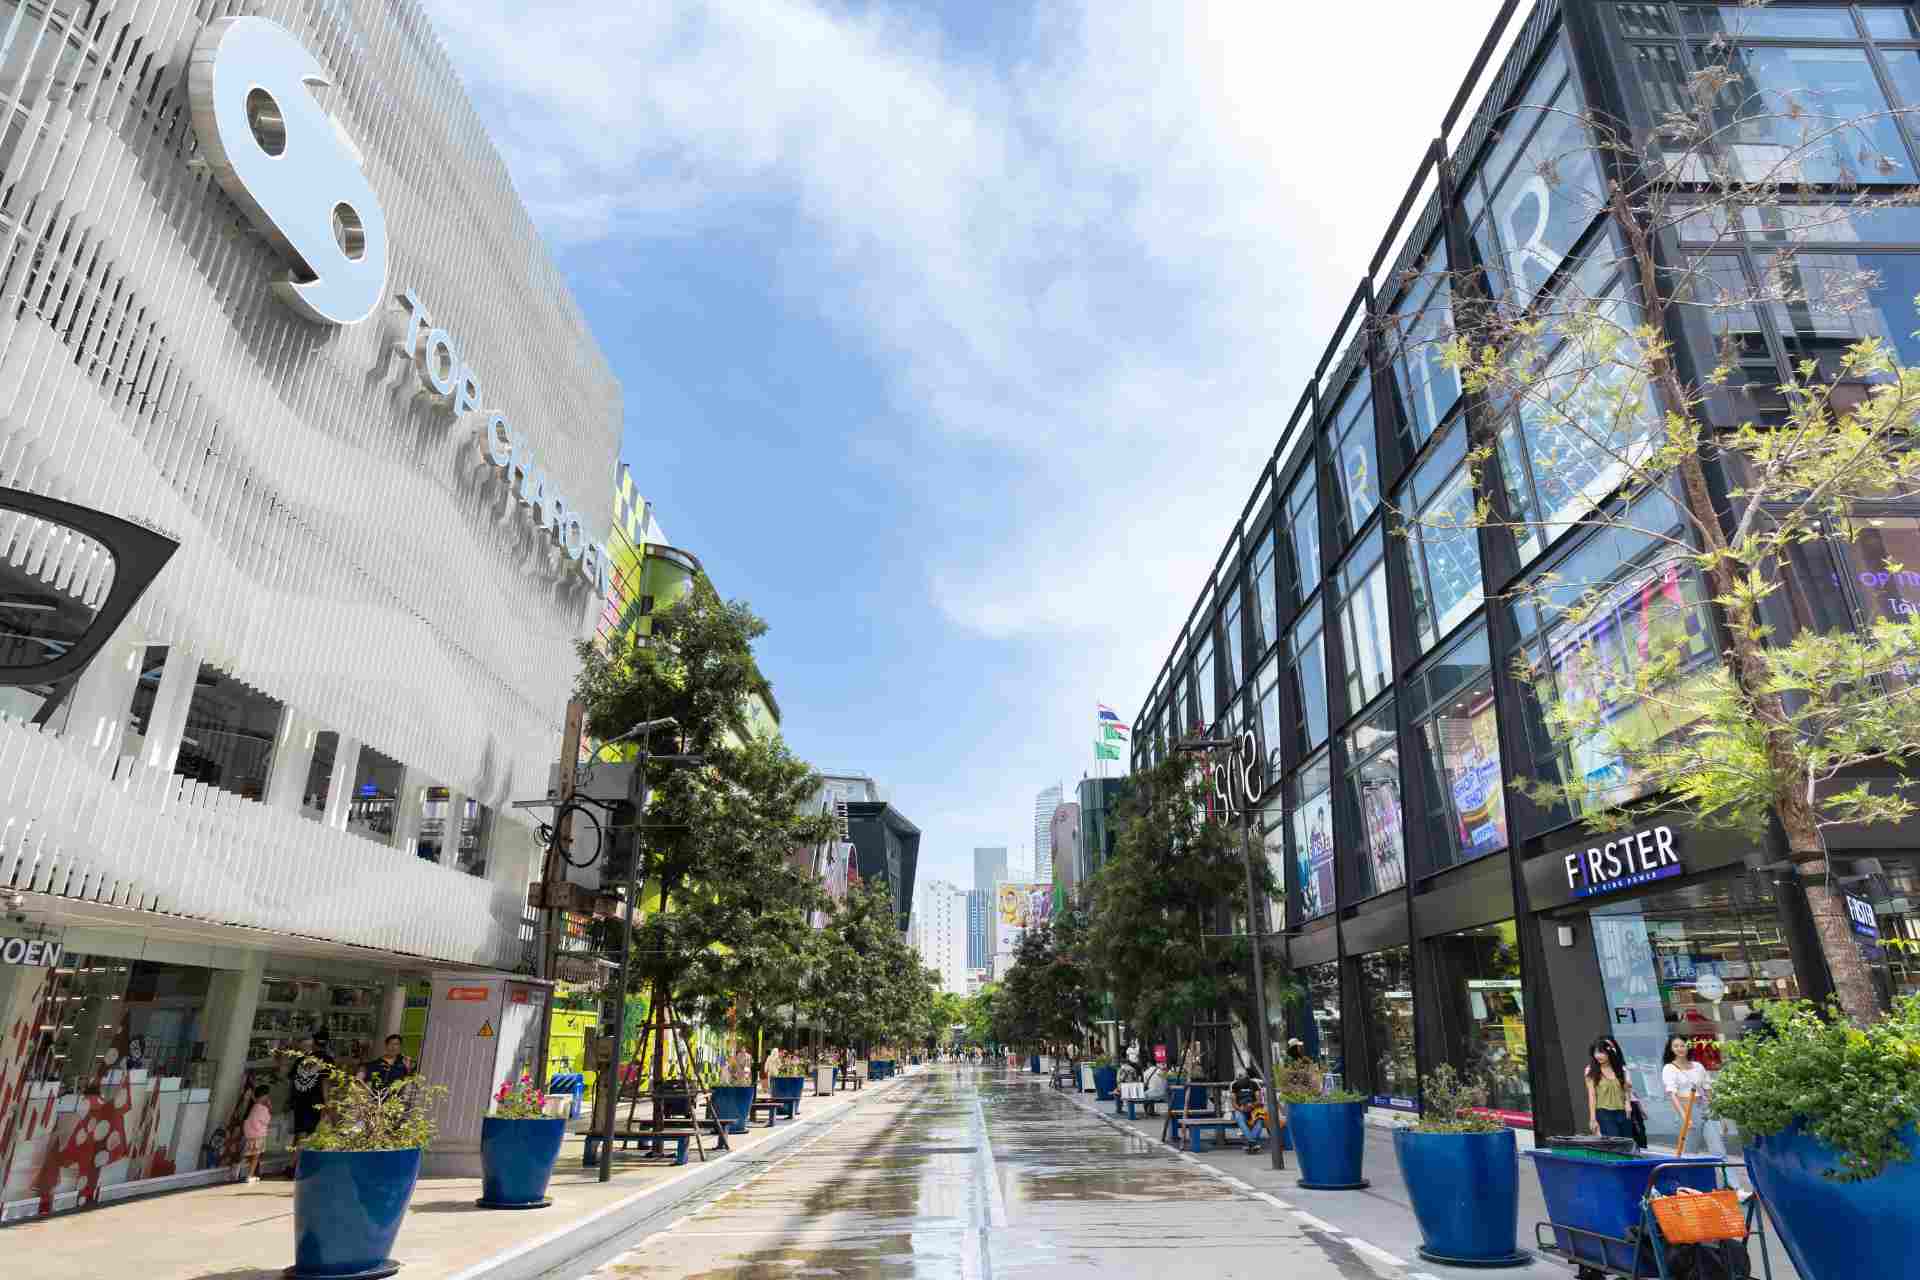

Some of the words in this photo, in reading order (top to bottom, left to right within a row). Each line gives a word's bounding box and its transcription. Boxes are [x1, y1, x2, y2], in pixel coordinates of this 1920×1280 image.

[395, 288, 482, 416] TOP
[483, 412, 609, 599] CHAROEN
[1564, 825, 1679, 889] FIRSTER
[0, 935, 62, 967] OEN
